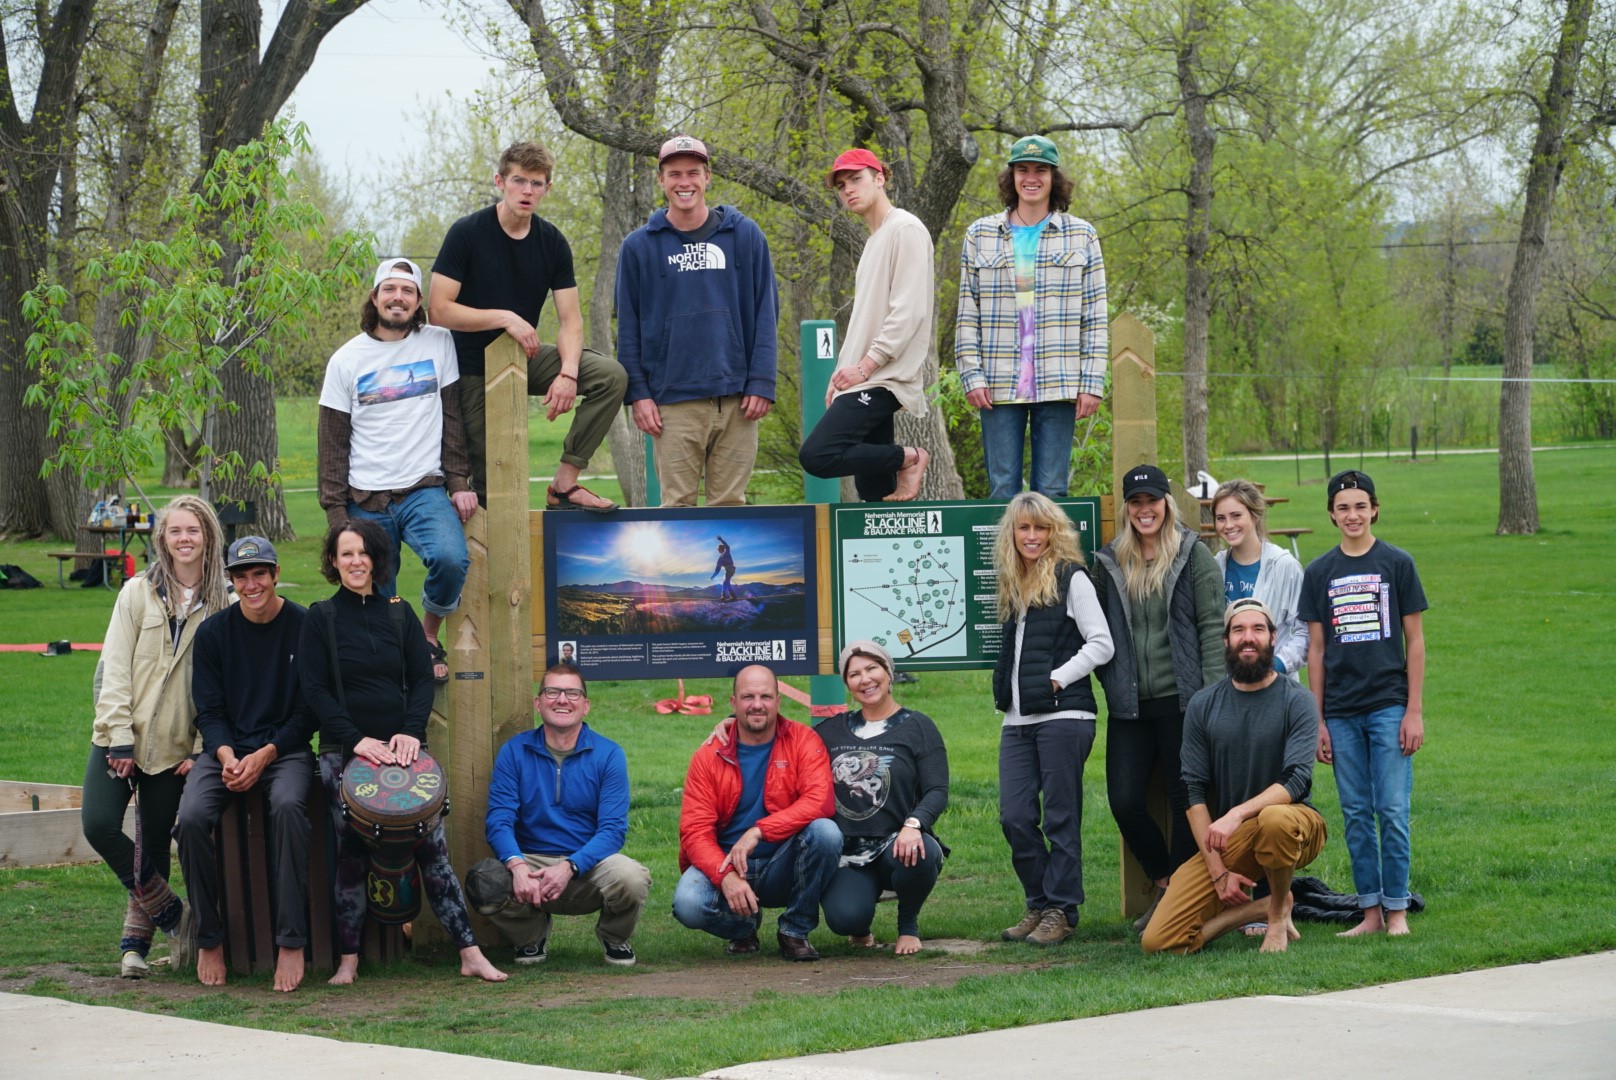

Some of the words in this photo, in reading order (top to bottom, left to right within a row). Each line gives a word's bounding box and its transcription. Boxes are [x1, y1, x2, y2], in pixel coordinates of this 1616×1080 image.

[682, 242, 706, 252] THE
[668, 252, 706, 264] NORTH
[680, 260, 706, 272] FACE
[865, 518, 926, 529] SLACKLINE
[1338, 604, 1372, 613] KOKOPELLI
[717, 646, 771, 656] SLACKLINE
